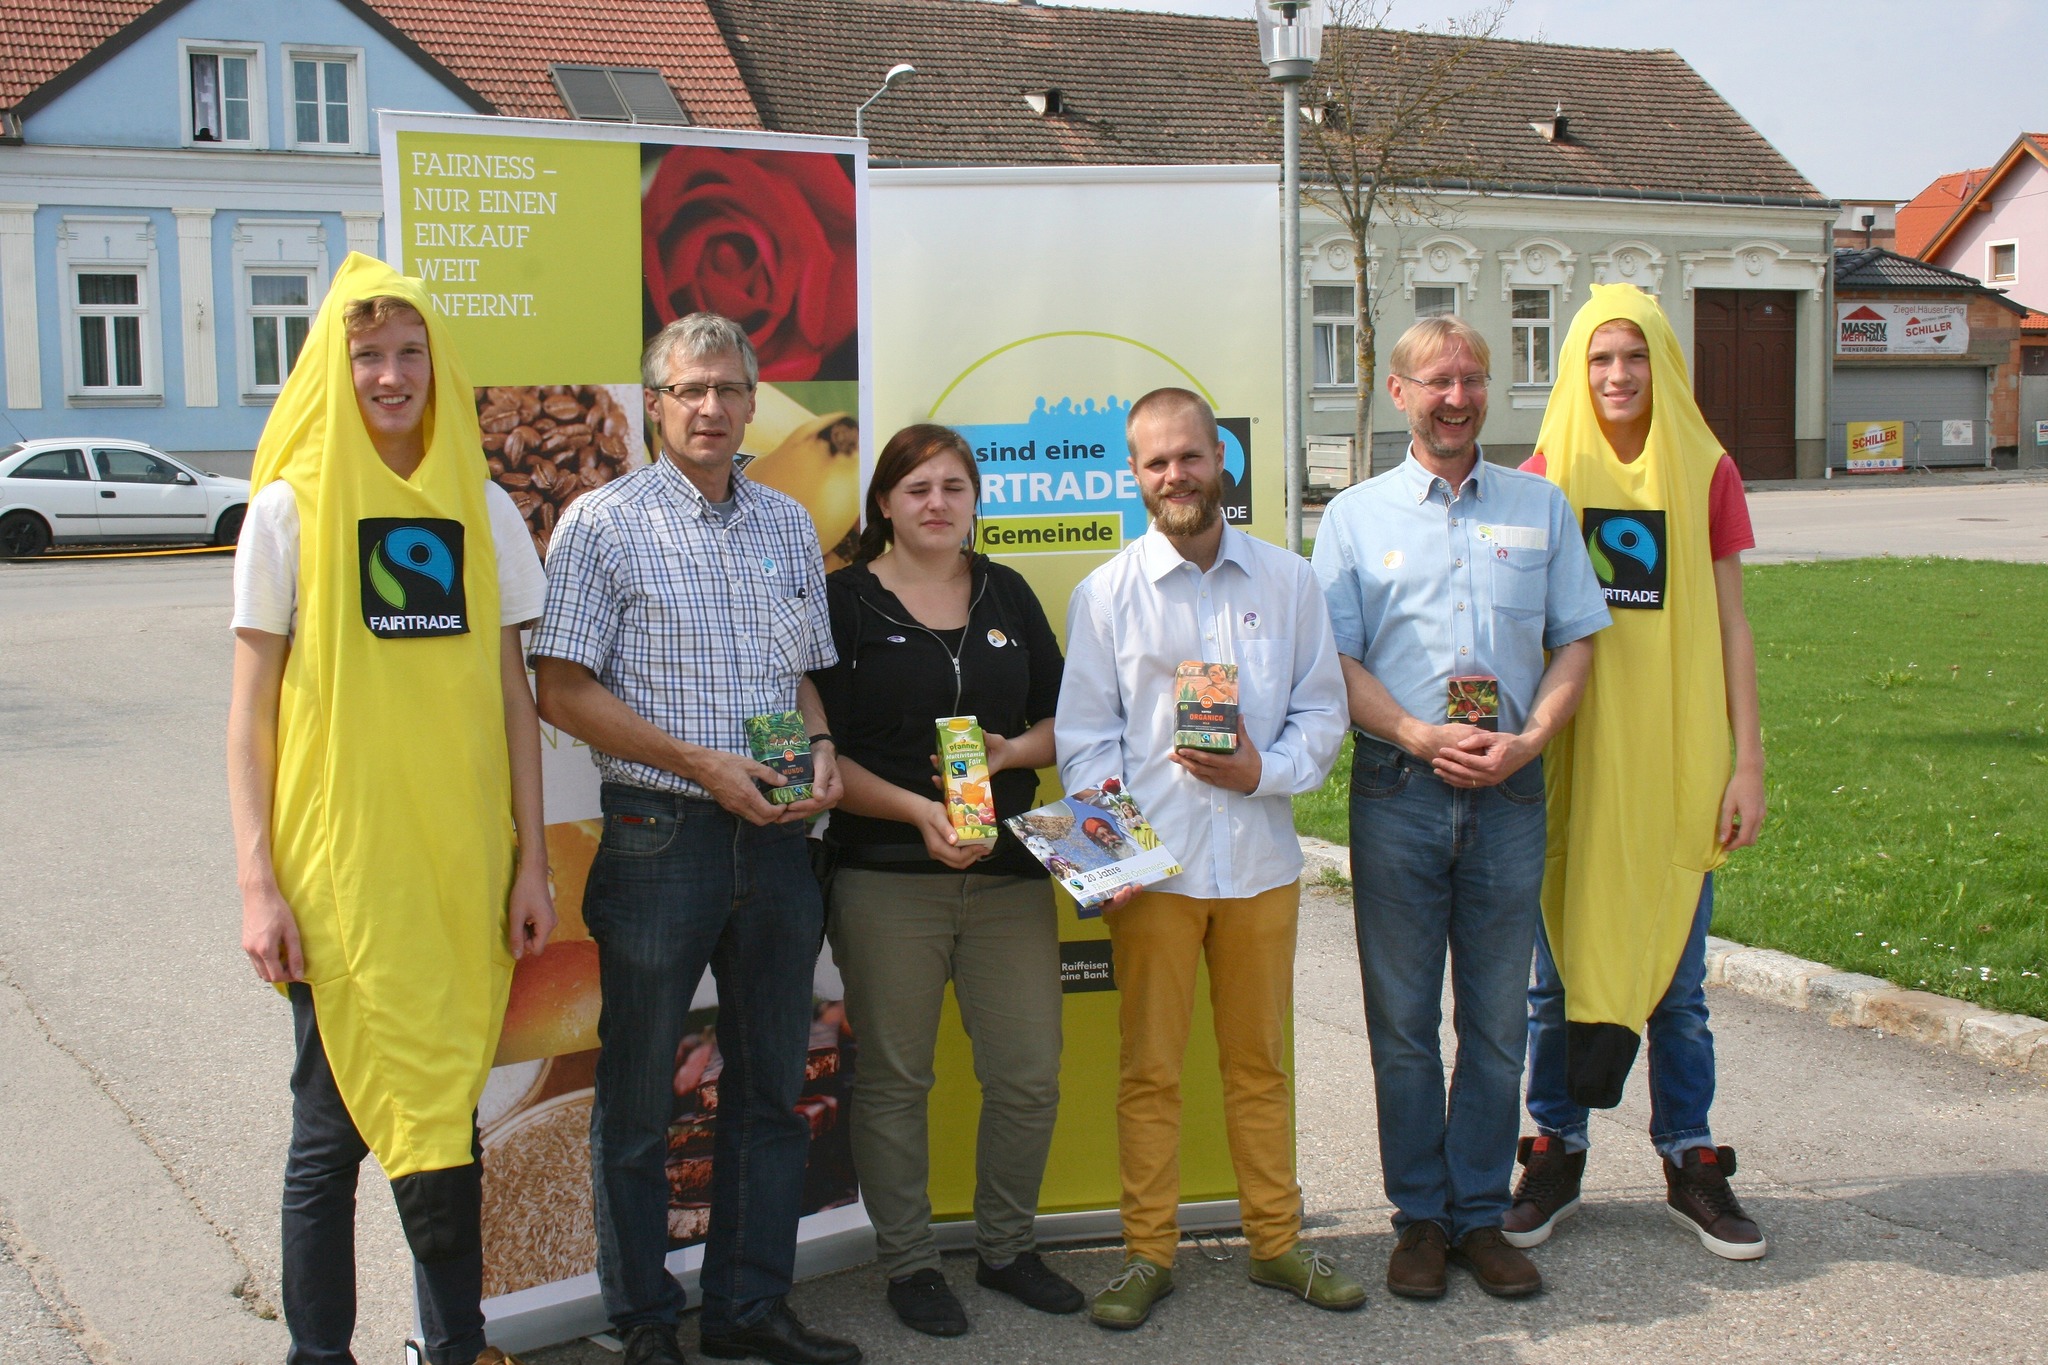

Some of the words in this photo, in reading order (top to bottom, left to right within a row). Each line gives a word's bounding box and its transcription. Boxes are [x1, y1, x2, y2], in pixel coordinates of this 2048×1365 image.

[411, 152, 535, 180] FAIRNESS
[413, 187, 469, 212] NUR
[479, 191, 557, 215] EINEN
[415, 223, 530, 248] EINKAUF
[415, 258, 480, 282] WEIT
[430, 293, 537, 317] NFERNT.
[1841, 322, 1887, 334] MASSIV
[1905, 321, 1952, 337] SCHILLER
[1841, 333, 1887, 342] WERTHAUS
[1852, 430, 1897, 449] SCHILLER
[976, 441, 1036, 462] sind
[1045, 440, 1106, 460] eine
[982, 470, 1137, 503] RTRADE
[983, 521, 1113, 545] Gemeinde
[1601, 588, 1659, 603] IRTRADE
[369, 615, 462, 631] FAIRTRADE
[1189, 713, 1224, 722] ORGANICO
[968, 758, 982, 767] Fair
[1084, 873, 1097, 883] 20
[1097, 866, 1122, 879] Jahre
[1091, 873, 1132, 890] FAIRTRADE
[1060, 971, 1081, 980] eine
[1083, 969, 1109, 980] Bank
[1061, 961, 1109, 971] Raiffeisen
